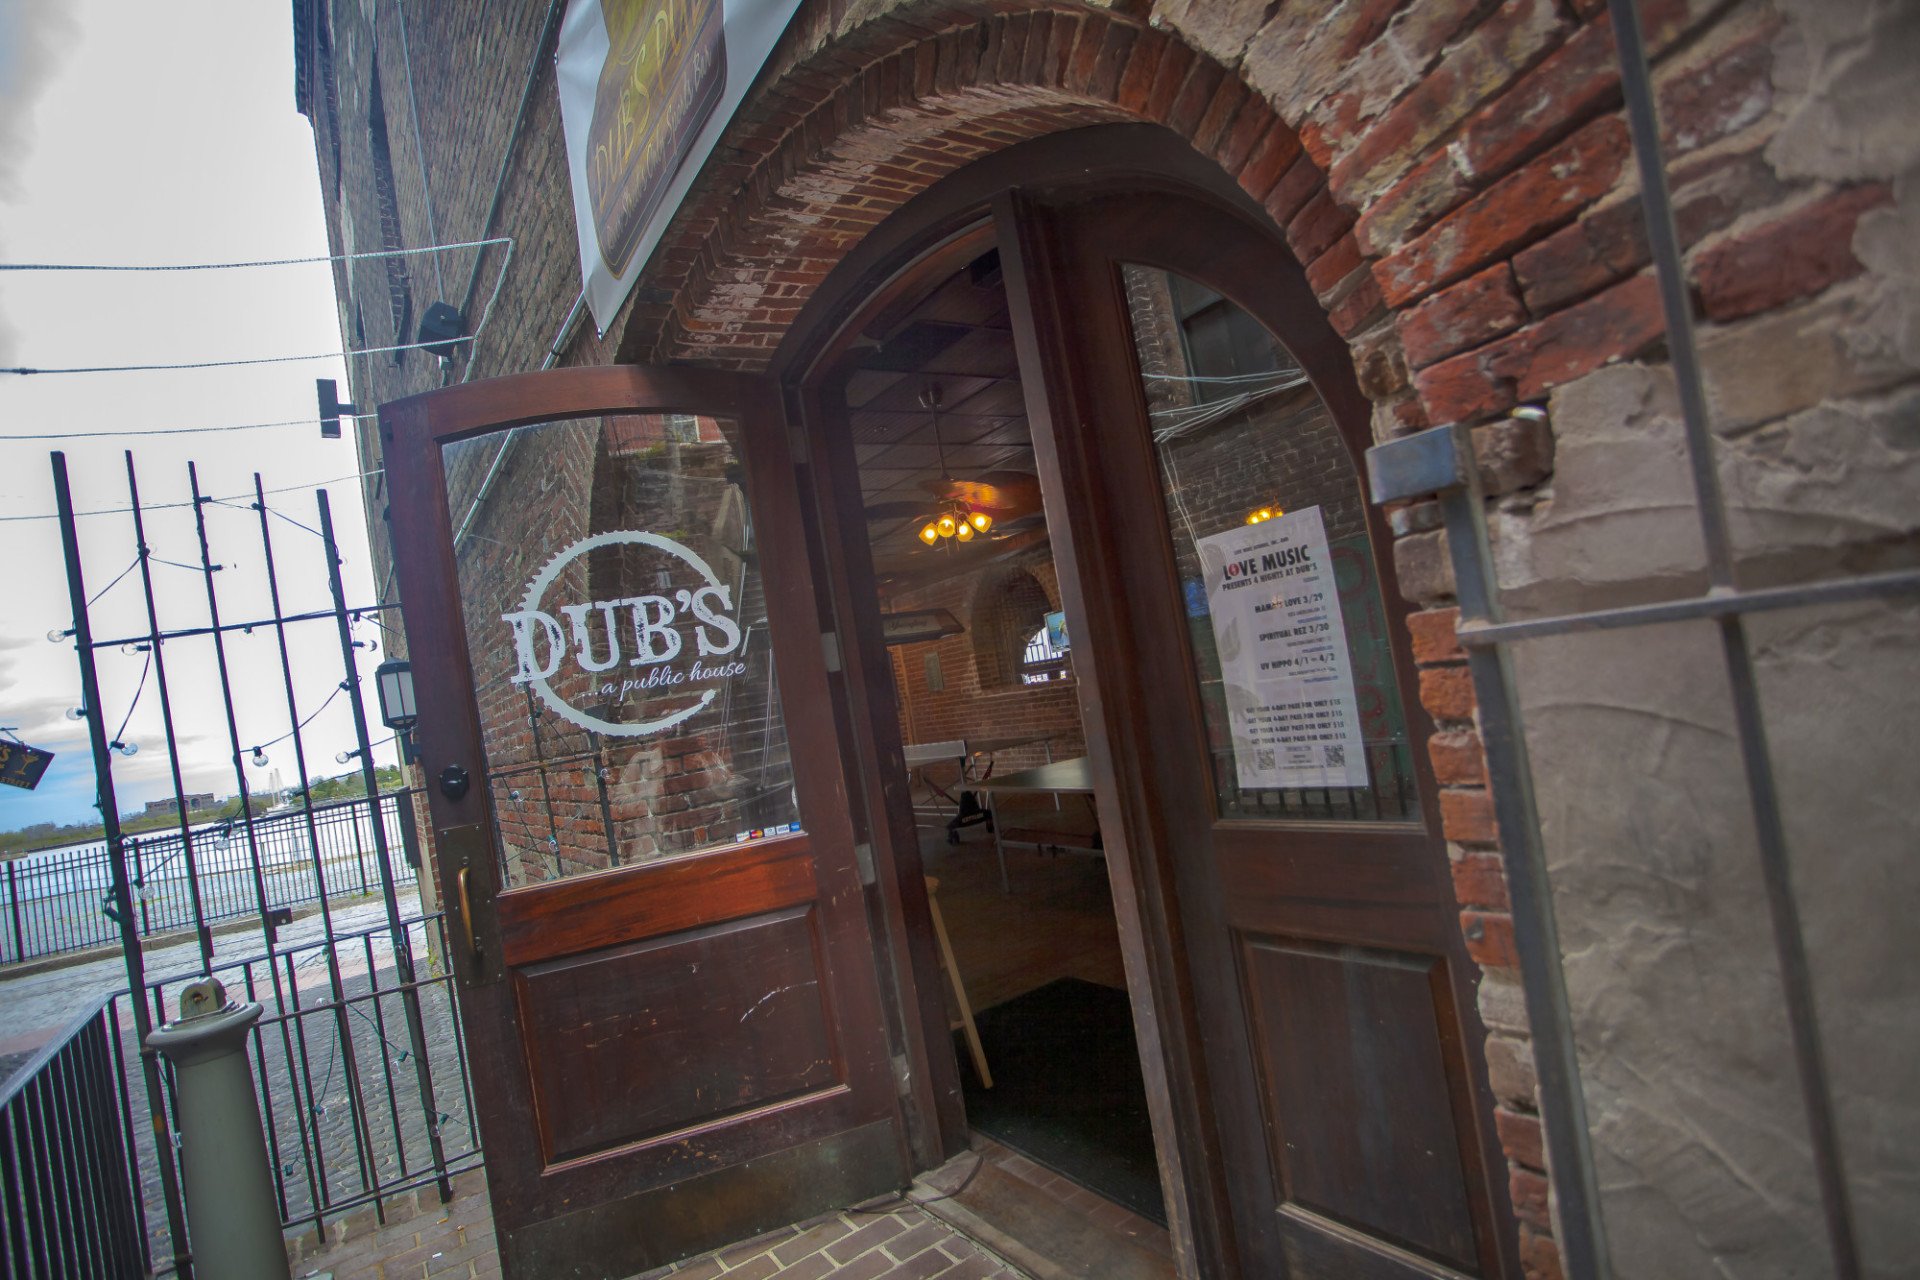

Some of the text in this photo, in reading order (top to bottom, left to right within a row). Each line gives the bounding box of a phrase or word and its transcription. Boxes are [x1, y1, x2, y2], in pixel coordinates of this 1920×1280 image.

[1222, 558, 1258, 580] LOVE
[1261, 544, 1310, 572] MUSIC
[1222, 562, 1318, 591] PRESENTS 4 NIGHTS AT DUB'S
[1284, 597, 1302, 608] LOVE
[1302, 592, 1324, 604] 3/29
[502, 585, 741, 684] DUB'S
[1259, 629, 1292, 642] SPIRITUAL
[1294, 626, 1307, 636] REZ
[1308, 622, 1330, 634] 3/30
[1260, 663, 1270, 671] UV
[1271, 659, 1292, 669] HIPPO
[1294, 656, 1308, 667] 4/1
[1320, 652, 1335, 663] 4/2
[620, 665, 684, 702] public
[689, 660, 746, 681] house
